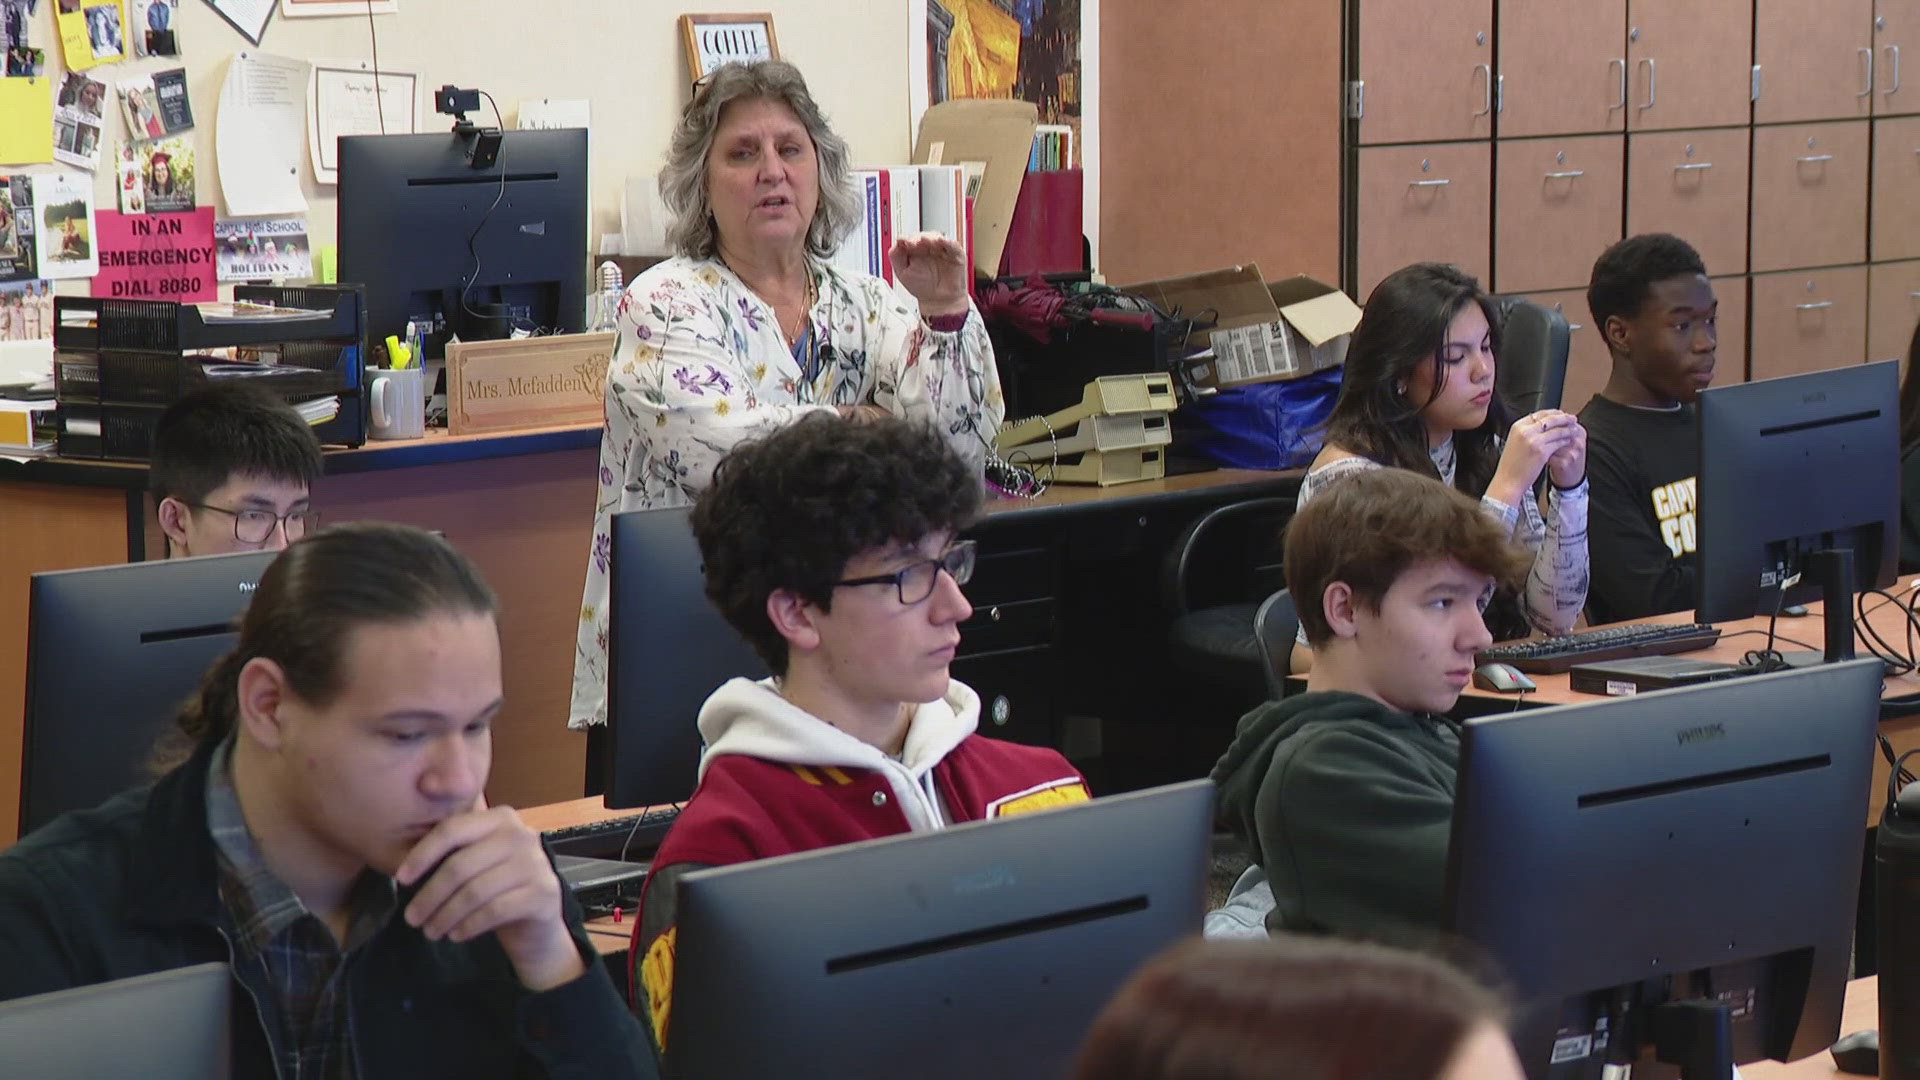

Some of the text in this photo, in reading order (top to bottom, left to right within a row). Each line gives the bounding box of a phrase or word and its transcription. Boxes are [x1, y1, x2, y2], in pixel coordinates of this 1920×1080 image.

[132, 219, 182, 236] IN AN
[214, 220, 304, 234] CAPITAL HIGH SCHOOL
[99, 248, 212, 267] EMERGENCY
[231, 263, 289, 274] HOLIDAYS
[112, 277, 201, 296] DIAL 8080
[467, 373, 581, 400] Mrs. Mcfadden
